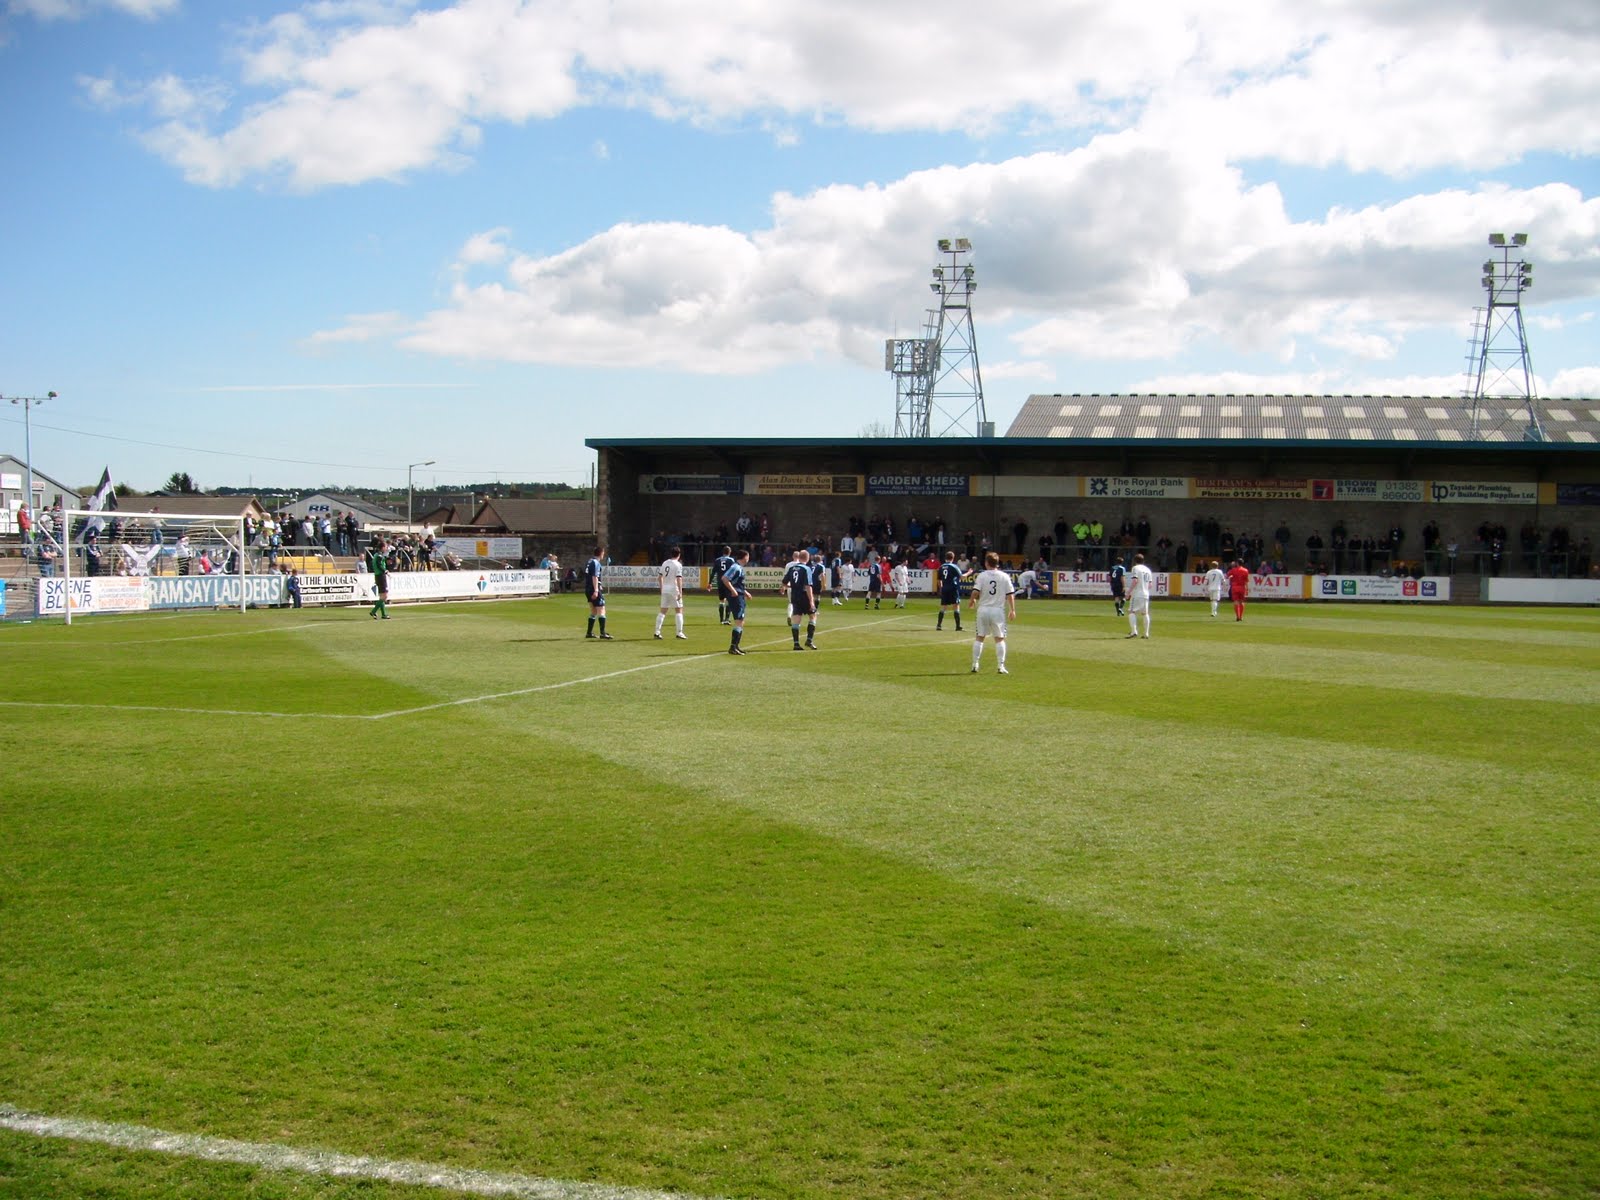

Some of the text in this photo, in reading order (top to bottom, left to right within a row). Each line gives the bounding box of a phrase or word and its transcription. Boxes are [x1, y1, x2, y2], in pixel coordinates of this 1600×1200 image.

[869, 476, 965, 485] GARDEN SHEDS
[1132, 478, 1157, 487] Royal
[1160, 478, 1183, 486] Bank
[1386, 482, 1417, 490] 01382
[1450, 484, 1475, 492] Tayside
[1125, 488, 1164, 496] Scotland
[720, 560, 726, 571] 5
[664, 565, 671, 577] 9
[943, 569, 948, 580] 9
[1112, 570, 1117, 578] 6
[324, 575, 358, 585] DOUGLAS
[490, 573, 504, 583] COLIN
[511, 573, 525, 582] SMITH
[792, 570, 799, 583] 9
[1058, 573, 1069, 582] R.
[1072, 573, 1083, 582] S.
[1212, 573, 1217, 581] 7
[1253, 576, 1291, 587] WATT
[149, 577, 280, 605] RAMSAY LADDERS
[989, 580, 997, 596] 3
